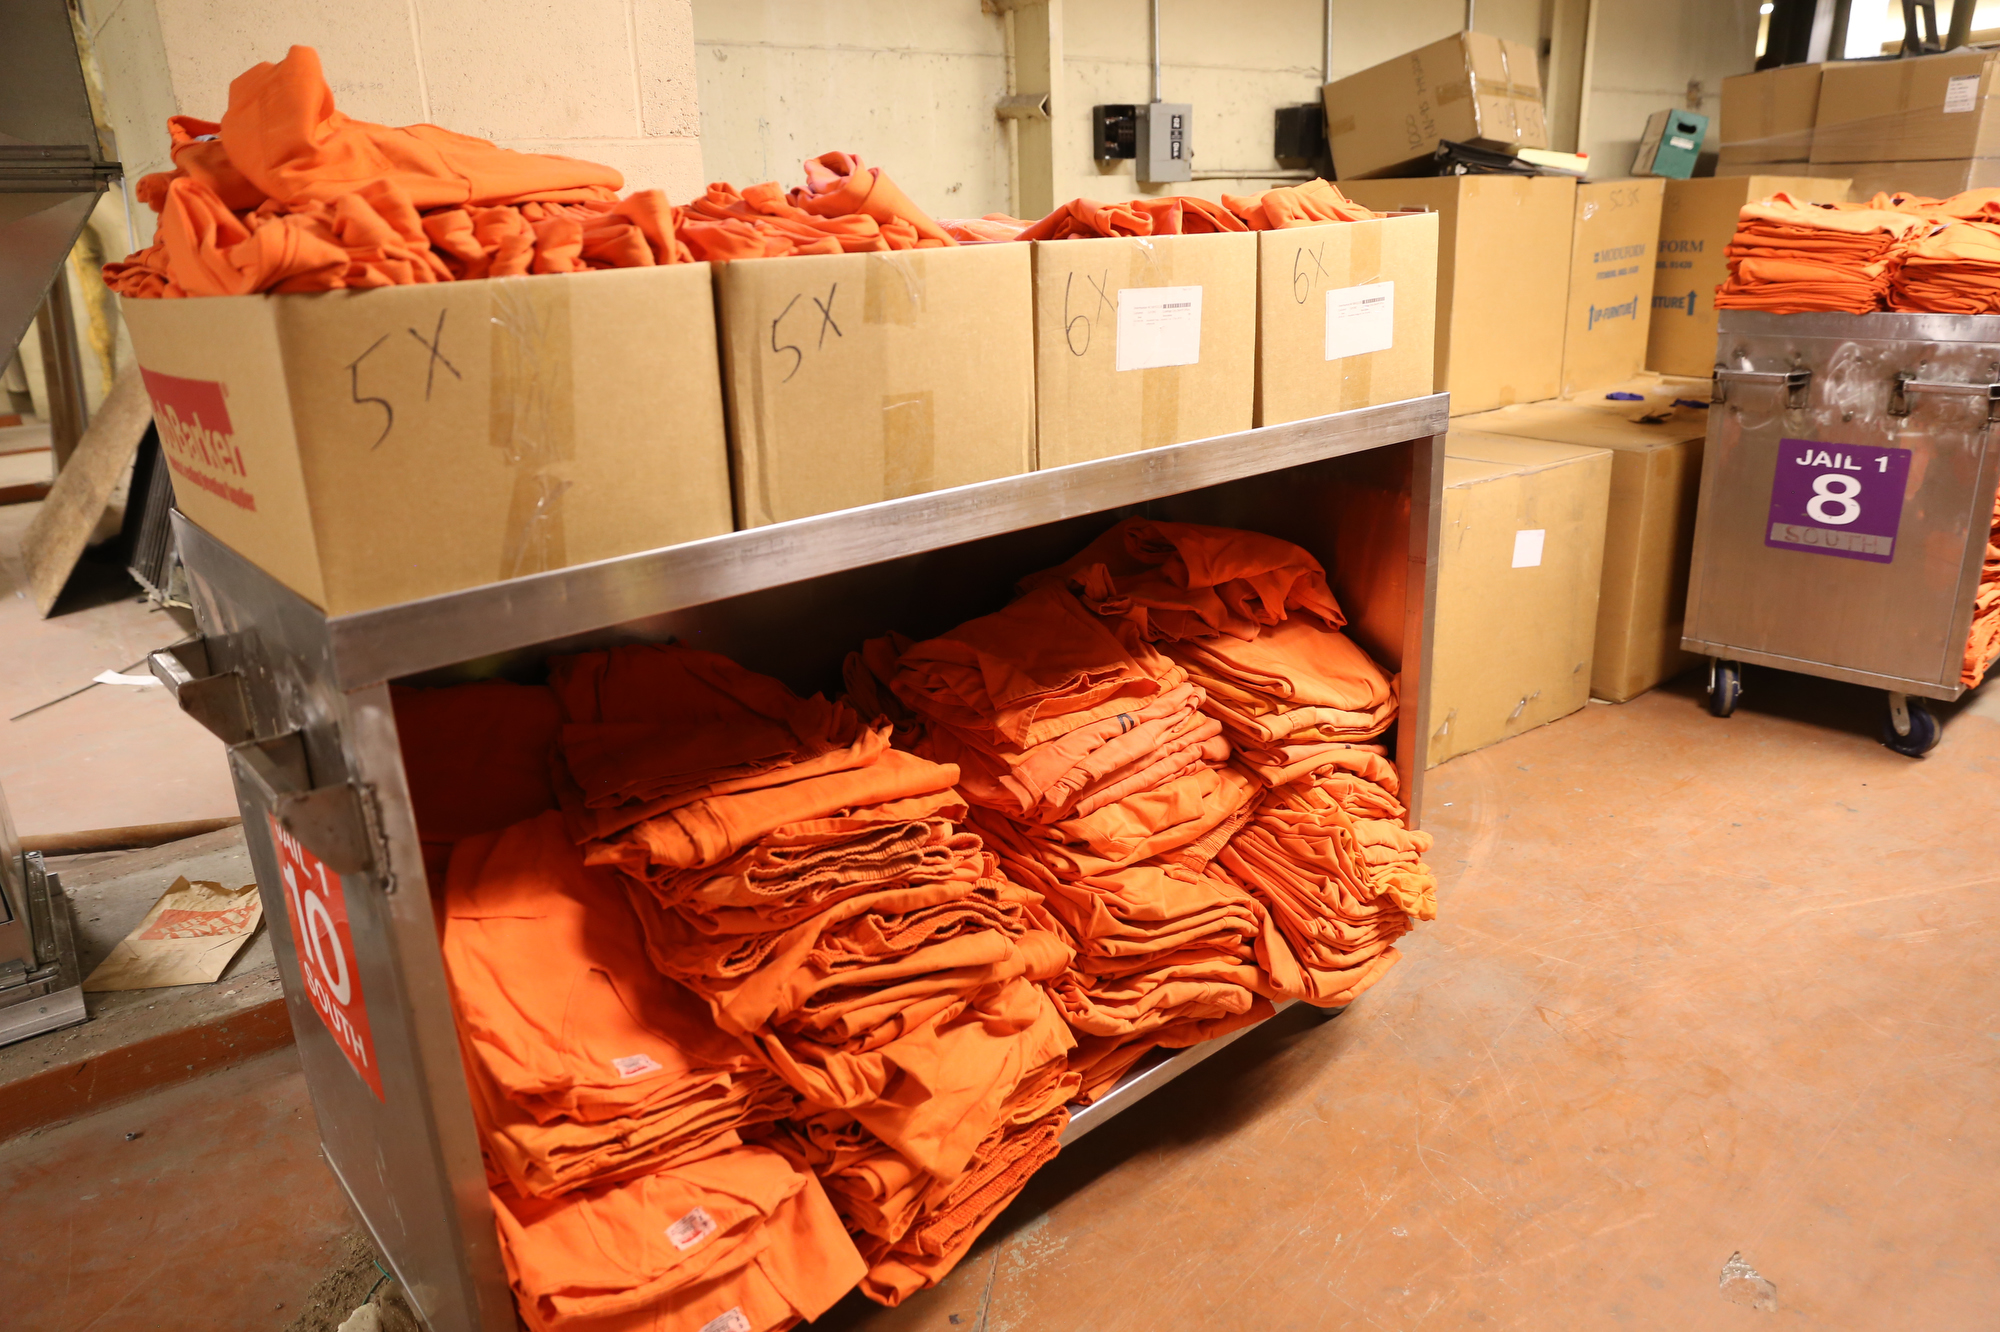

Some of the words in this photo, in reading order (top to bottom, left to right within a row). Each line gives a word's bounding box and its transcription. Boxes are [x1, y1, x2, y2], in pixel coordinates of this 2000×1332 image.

[1293, 241, 1330, 305] 6X
[770, 282, 843, 384] 5X
[1064, 268, 1116, 357] 6X
[345, 307, 462, 451] 5X
[163, 403, 248, 478] Barker
[1795, 449, 1862, 471] JAIL
[1874, 455, 1889, 473] 1
[1805, 473, 1862, 525] 8
[1783, 524, 1879, 555] SOUTH
[314, 860, 330, 898] 1
[282, 860, 352, 1006] 10
[303, 959, 369, 1068] SOUTH
